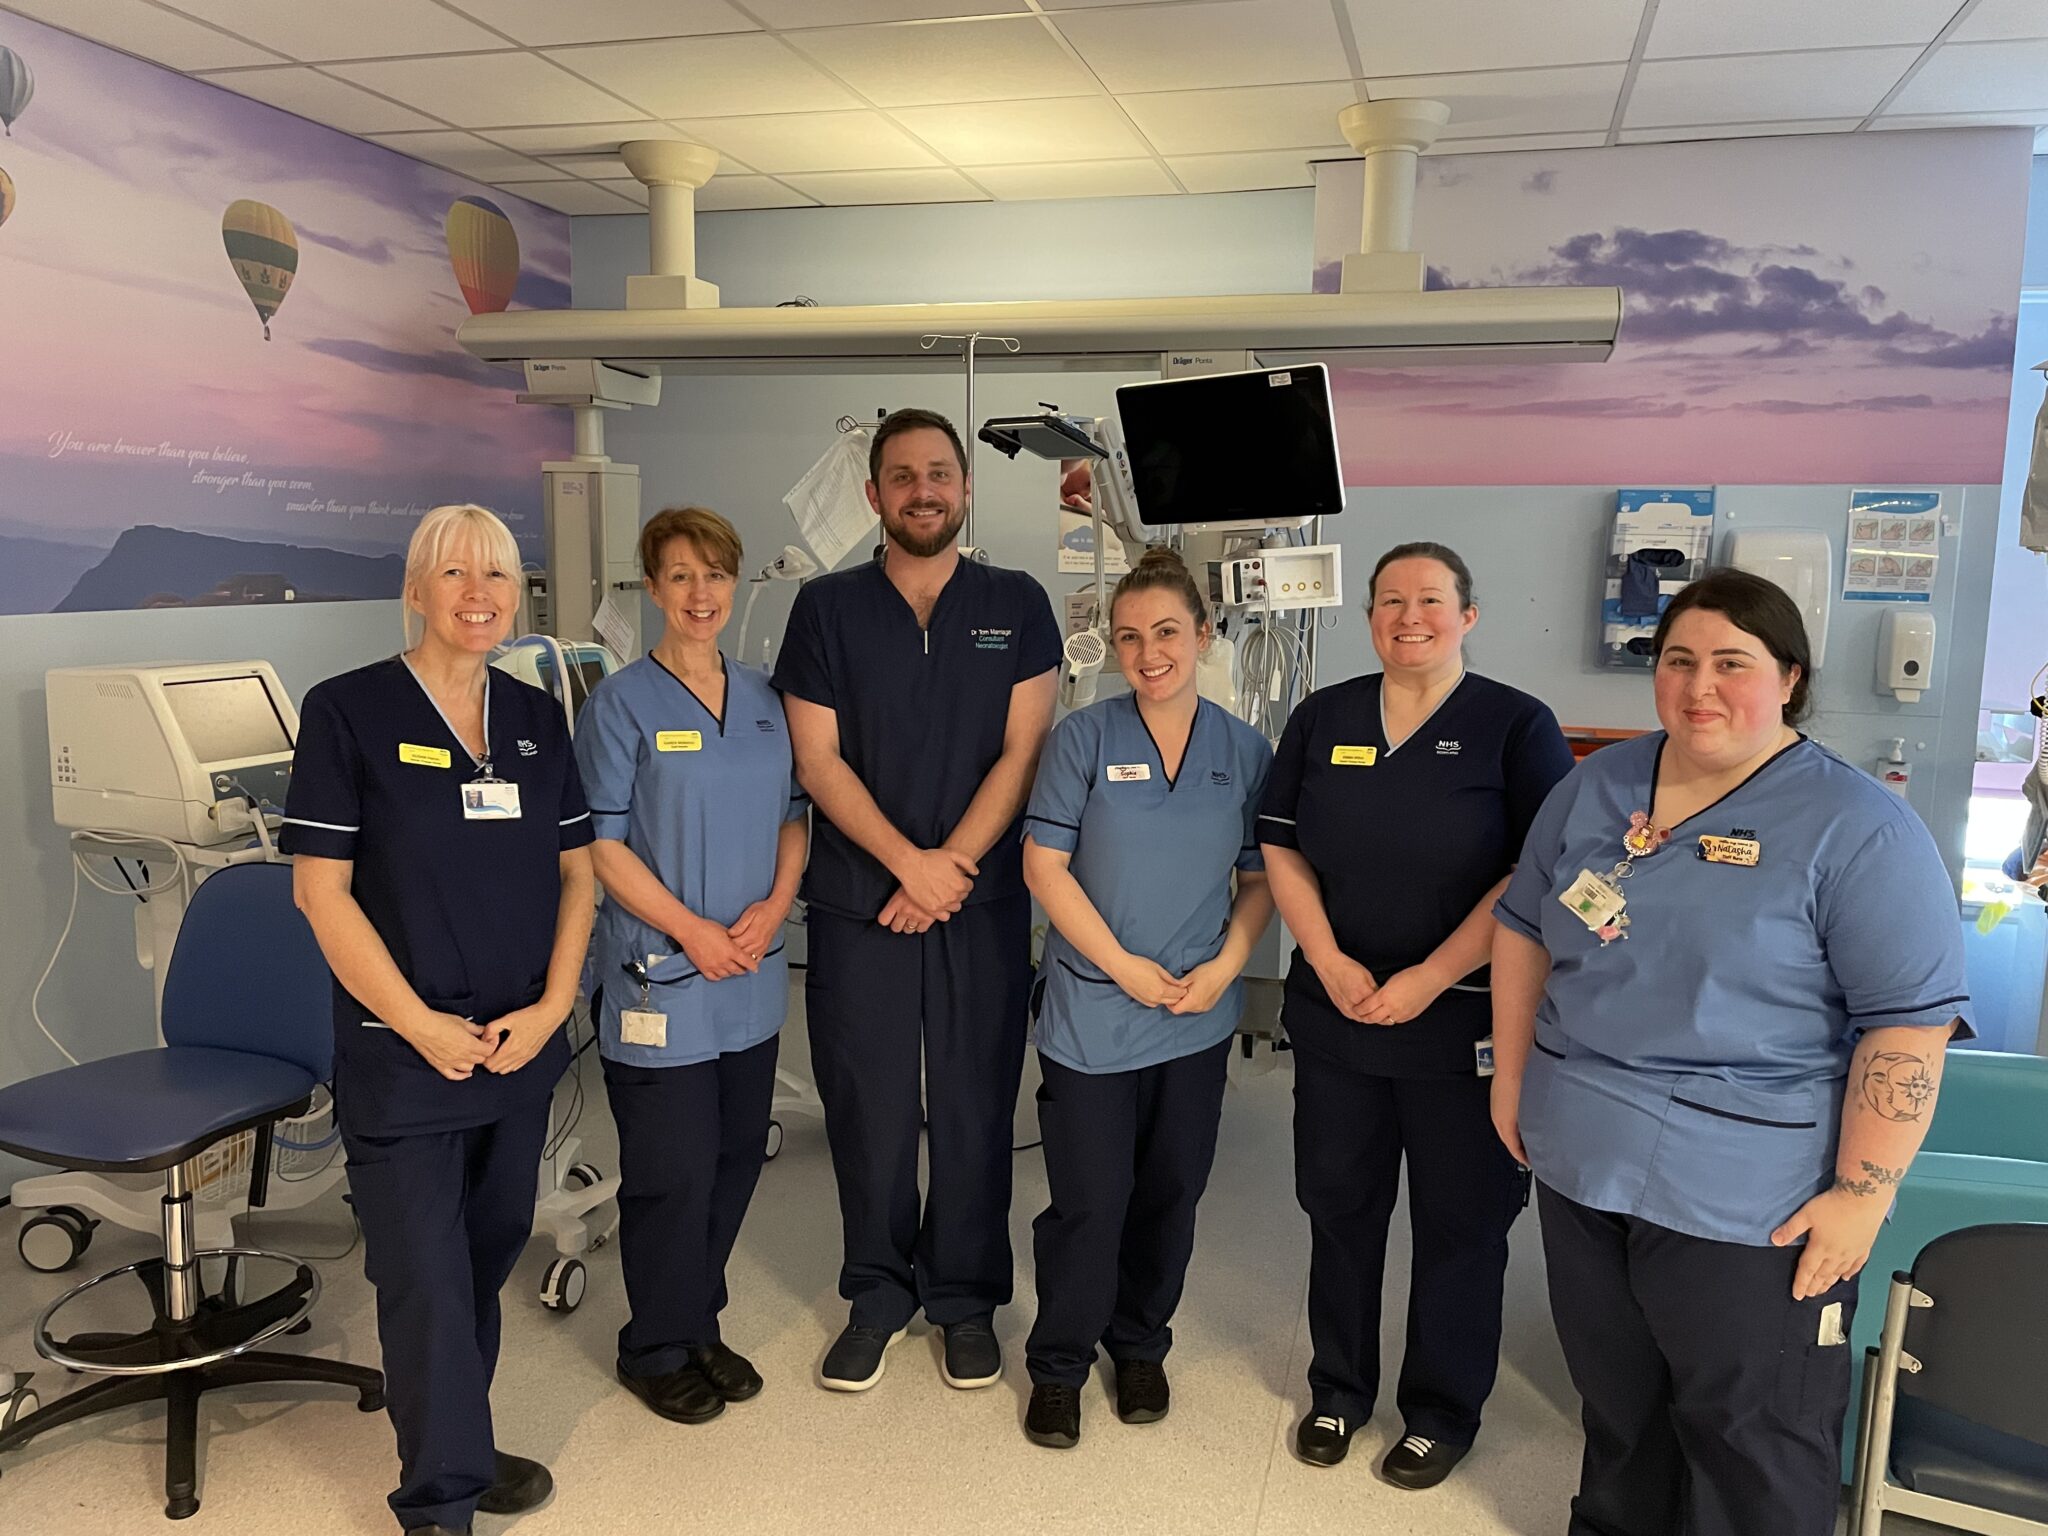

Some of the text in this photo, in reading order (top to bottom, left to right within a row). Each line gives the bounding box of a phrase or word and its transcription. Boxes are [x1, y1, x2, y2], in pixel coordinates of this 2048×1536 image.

[47, 431, 84, 458] You
[87, 442, 112, 453] are
[113, 437, 157, 456] braver
[158, 441, 186, 458] than
[187, 449, 209, 468] you
[192, 469, 239, 493] stronger
[241, 471, 266, 488] than
[268, 478, 287, 496] you
[286, 498, 325, 513] smarter
[326, 498, 348, 513] than
[349, 505, 367, 520] you
[1438, 740, 1460, 748] NHS
[1730, 828, 1757, 838] NHS
[1717, 844, 1752, 856] Natasha
